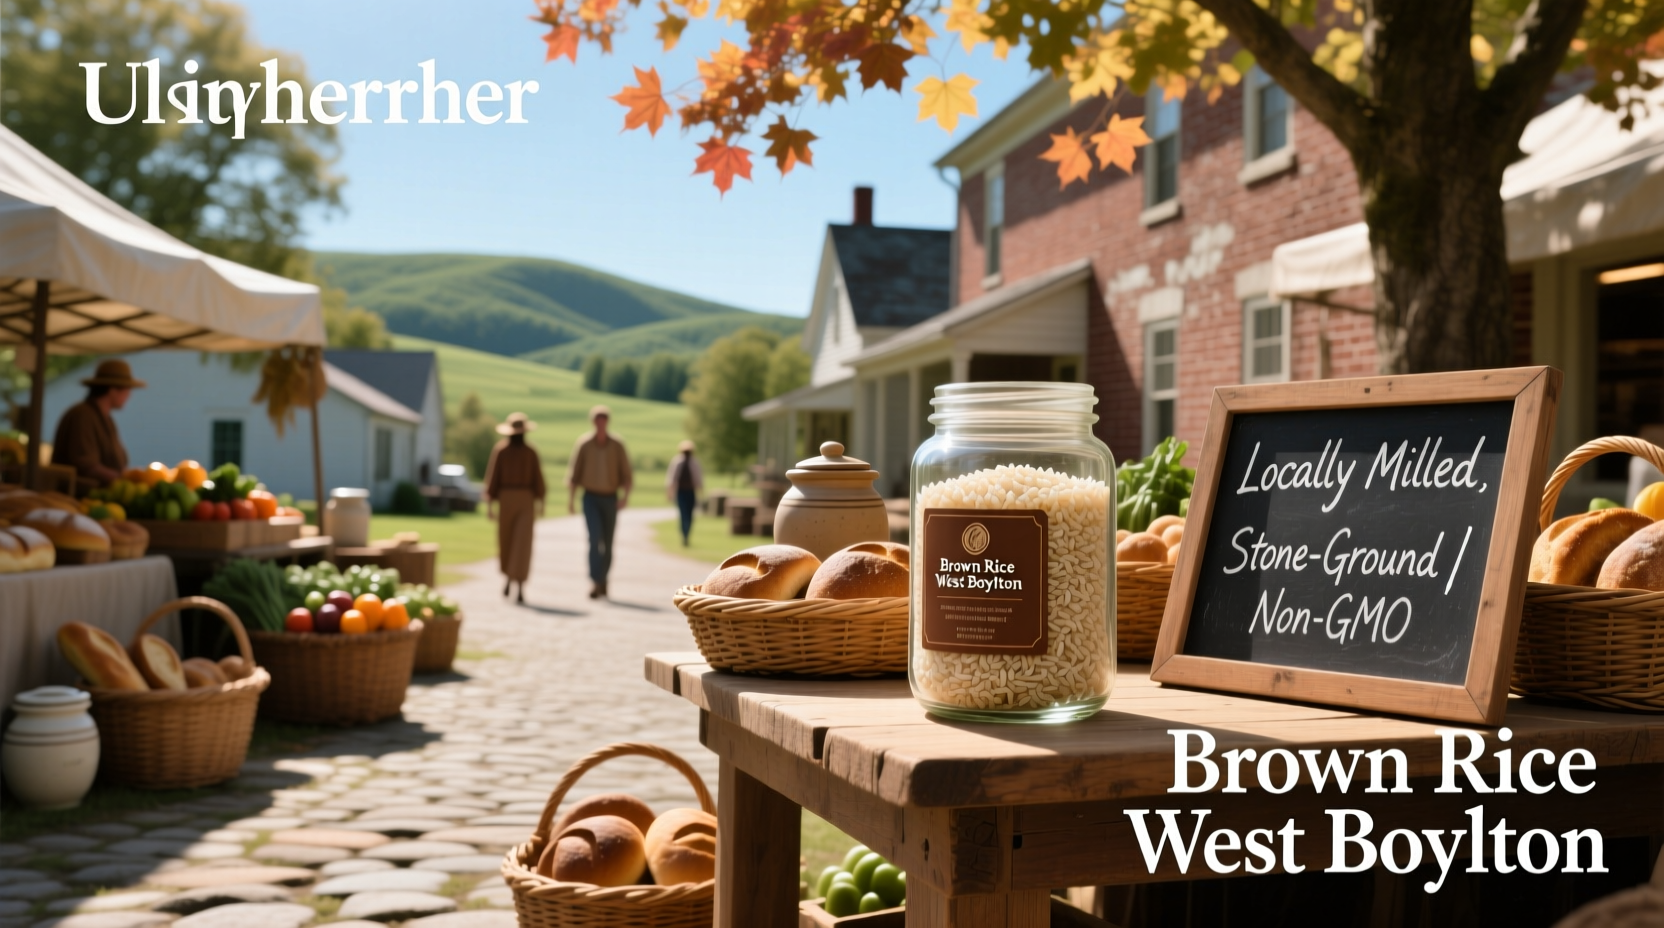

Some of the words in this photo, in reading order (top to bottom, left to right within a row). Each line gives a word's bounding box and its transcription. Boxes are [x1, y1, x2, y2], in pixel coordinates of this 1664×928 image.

[1236, 437, 1357, 513] Locally
[1364, 435, 1488, 493] Milled,
[940, 558, 980, 572] Brown
[984, 559, 1015, 573] Rice
[967, 575, 1022, 592] Boylton
[1222, 525, 1445, 586] Stone-Ground
[1248, 587, 1413, 644] Non-GMO
